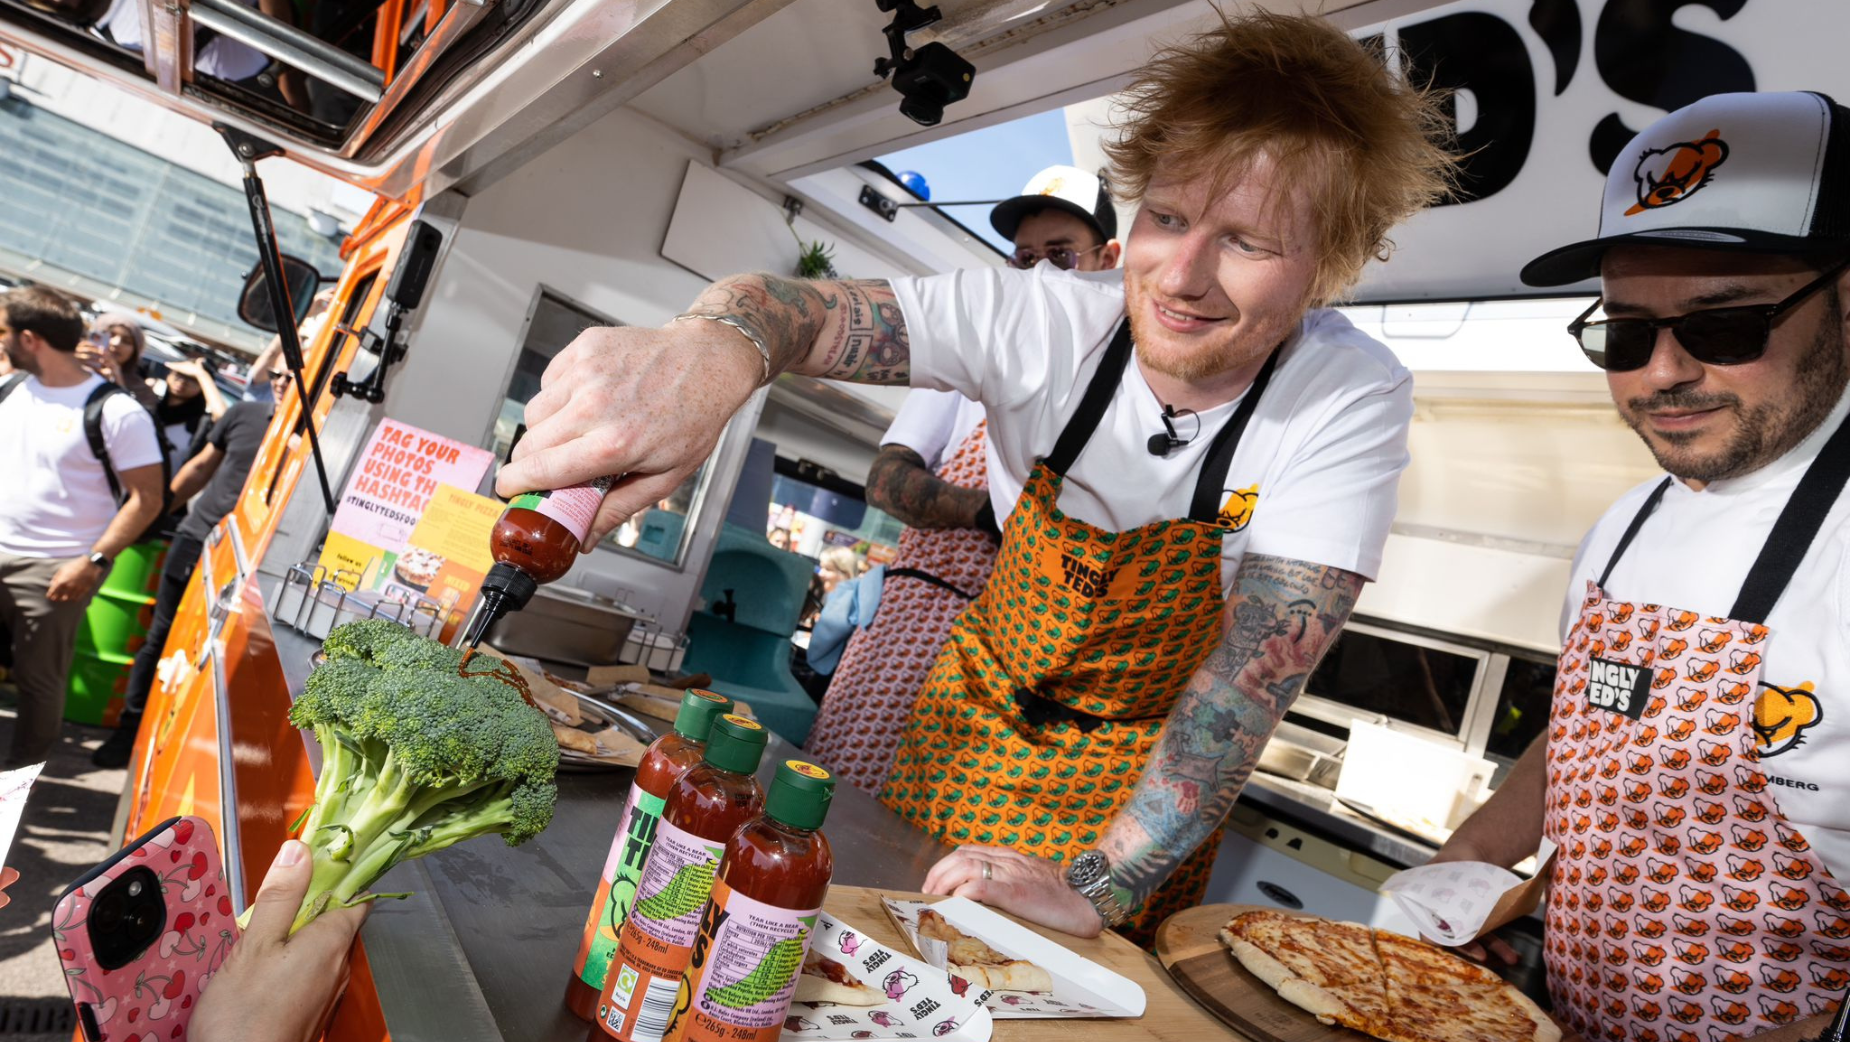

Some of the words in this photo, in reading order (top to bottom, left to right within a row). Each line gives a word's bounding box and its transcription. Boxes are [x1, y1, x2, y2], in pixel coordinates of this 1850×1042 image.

[1356, 0, 1757, 207] D'S
[381, 426, 414, 449] TAG
[417, 438, 460, 464] YOUR
[371, 442, 435, 475] PHOTOS
[364, 458, 412, 487] USING
[415, 476, 438, 496] TH
[346, 496, 418, 526] #TINGLYTEDSFOO
[1061, 554, 1120, 586] TINGLY
[1590, 660, 1640, 691] NGLY
[749, 914, 764, 922] TEAR
[750, 921, 768, 930] (THEN
[646, 938, 669, 954] 248ml
[862, 949, 885, 966] TED'S
[866, 952, 892, 974] TINGLY
[910, 997, 933, 1013] TED'S
[974, 990, 994, 1007] ED'S
[914, 1001, 941, 1020] TINGLY
[731, 1028, 757, 1040] 248ml
